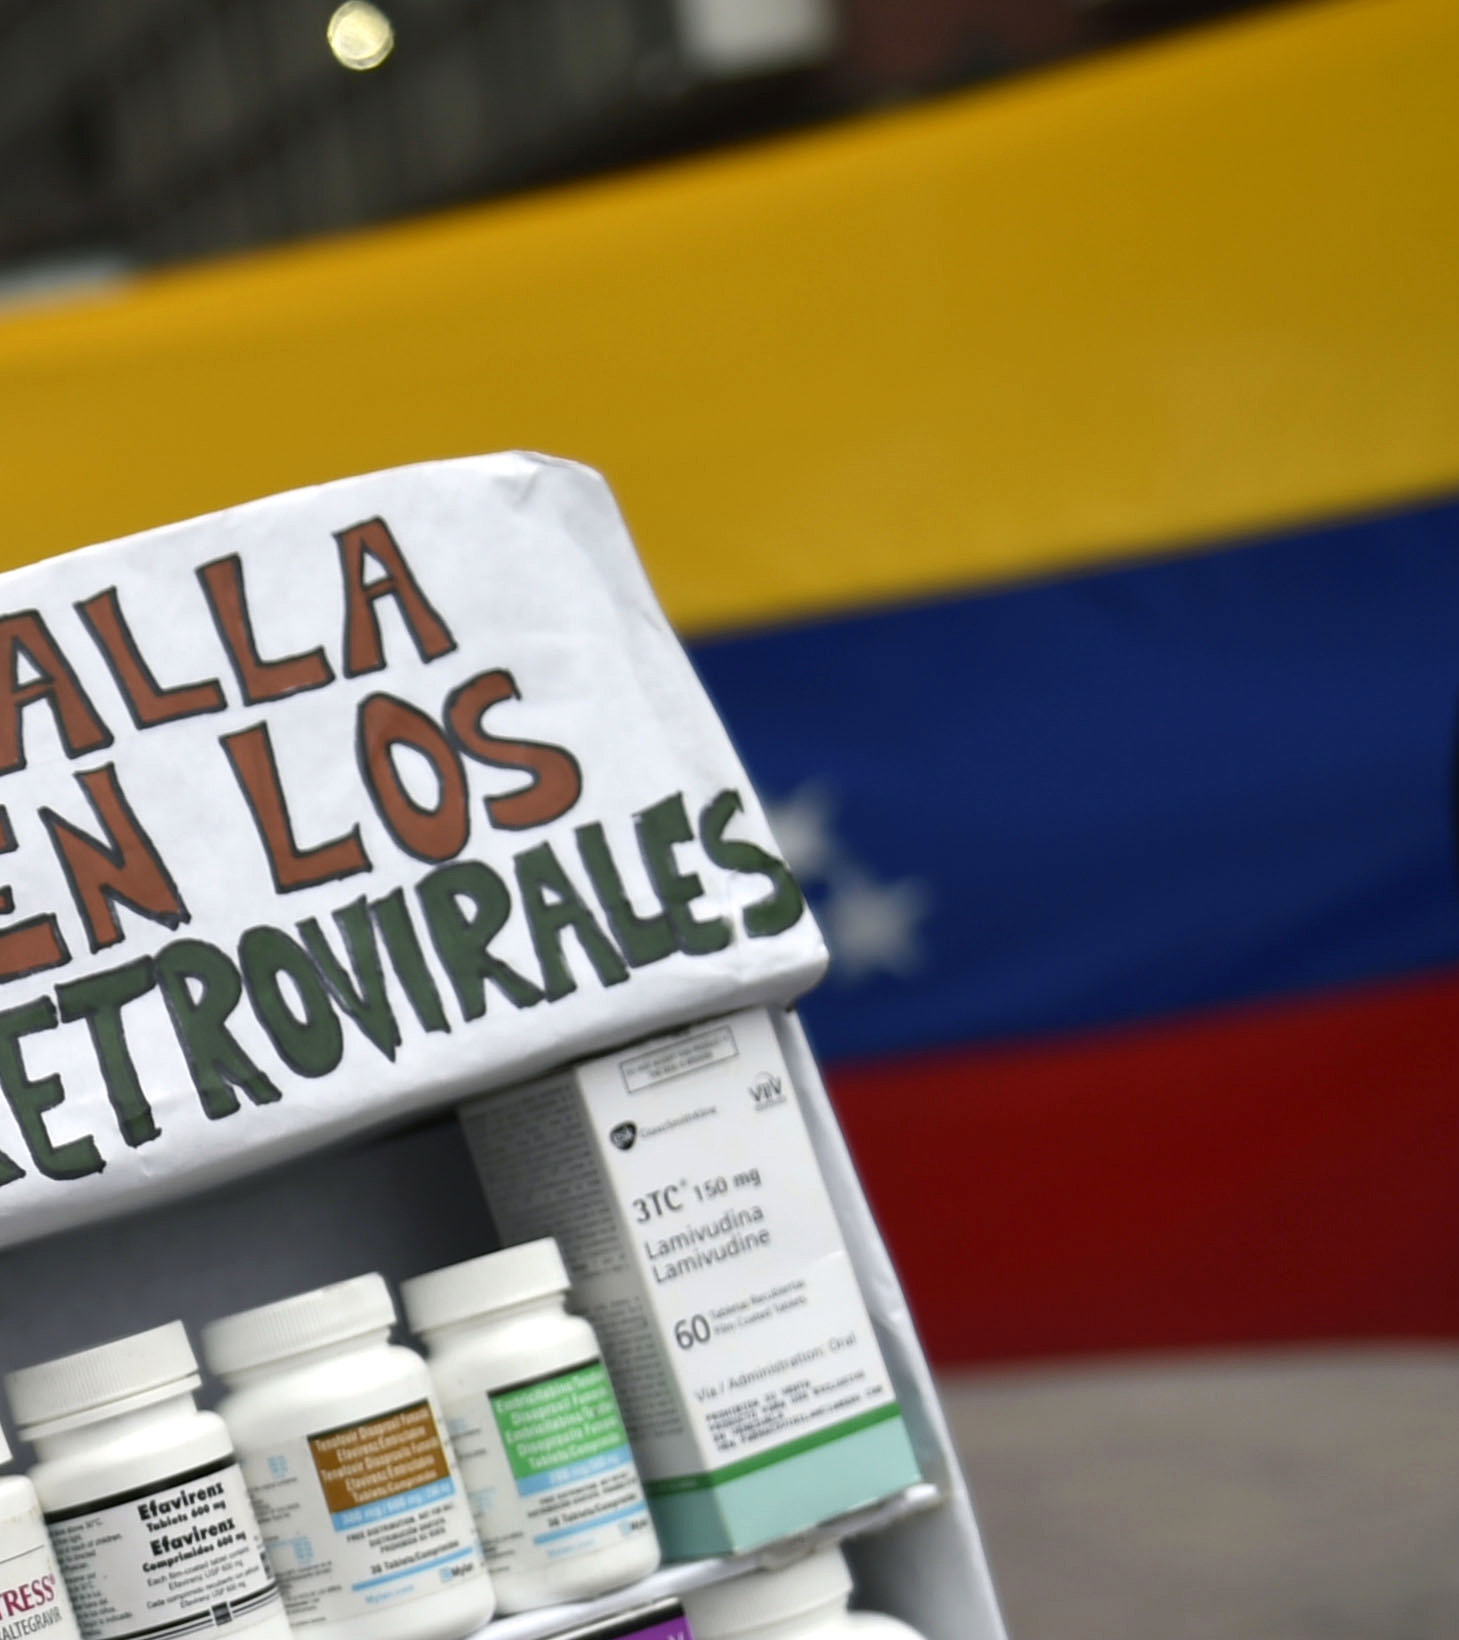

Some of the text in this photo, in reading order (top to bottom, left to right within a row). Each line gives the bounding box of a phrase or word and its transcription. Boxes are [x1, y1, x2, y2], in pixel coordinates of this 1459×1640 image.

[221, 668, 583, 894] LOS
[694, 1170, 761, 1201] 150 mg
[645, 1207, 764, 1261] Lamivudina
[652, 1230, 769, 1284] Lamivudine
[674, 1315, 711, 1350] 60
[138, 1483, 224, 1521] Efavirenz
[150, 1518, 235, 1556] Efavirenz
